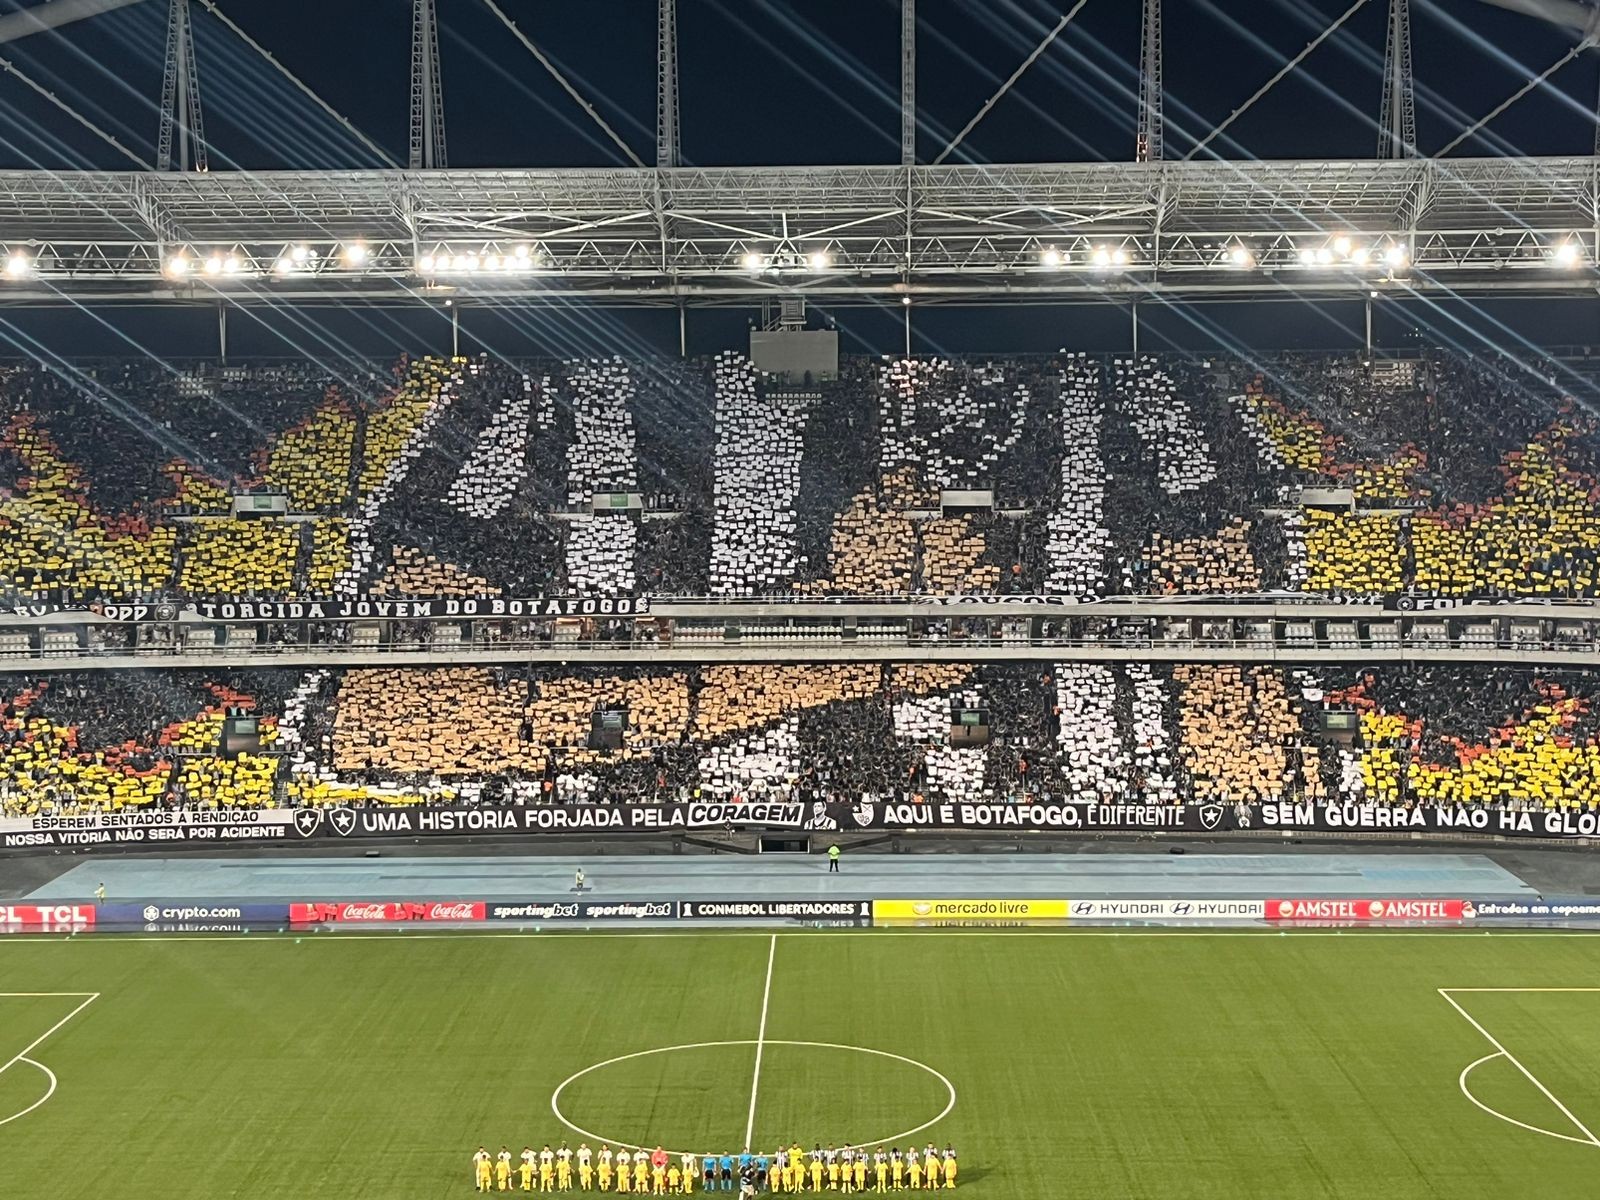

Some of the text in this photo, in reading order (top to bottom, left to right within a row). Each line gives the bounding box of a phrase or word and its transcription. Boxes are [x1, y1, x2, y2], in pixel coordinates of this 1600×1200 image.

[202, 599, 631, 618] TORCIDA JOVEM DO BOTAFOGO
[32, 816, 97, 829] ESPEREM
[101, 812, 173, 827] SENTADOS
[363, 802, 801, 831] UMA HISTÓRIA FORJADA PELA CORAGEM
[883, 804, 934, 824] AQUI
[939, 801, 955, 824] É
[961, 804, 1082, 828] BOTAFOGO,
[1100, 805, 1185, 826] DIFERENTE
[1262, 804, 1315, 825] SEM
[1325, 806, 1426, 827] GUERRA
[1544, 812, 1600, 835] GLO
[5, 826, 285, 846] NOSSA VITÓRIA NÃO SERÁ POR ACIDENTE
[36, 905, 87, 923] TCL
[162, 906, 241, 920] crypto.com
[494, 903, 579, 919] sportingbet
[586, 902, 672, 918] sportingbet
[698, 903, 855, 915] CONMEBOL LIBERTADORES
[935, 902, 1029, 914] mercado livre
[1100, 903, 1164, 914] HYUNDAI
[1198, 903, 1262, 914] HYUNDAI
[1295, 901, 1356, 917] AMSTEL
[1386, 901, 1447, 917] AMSTEL
[1531, 905, 1549, 914] em
